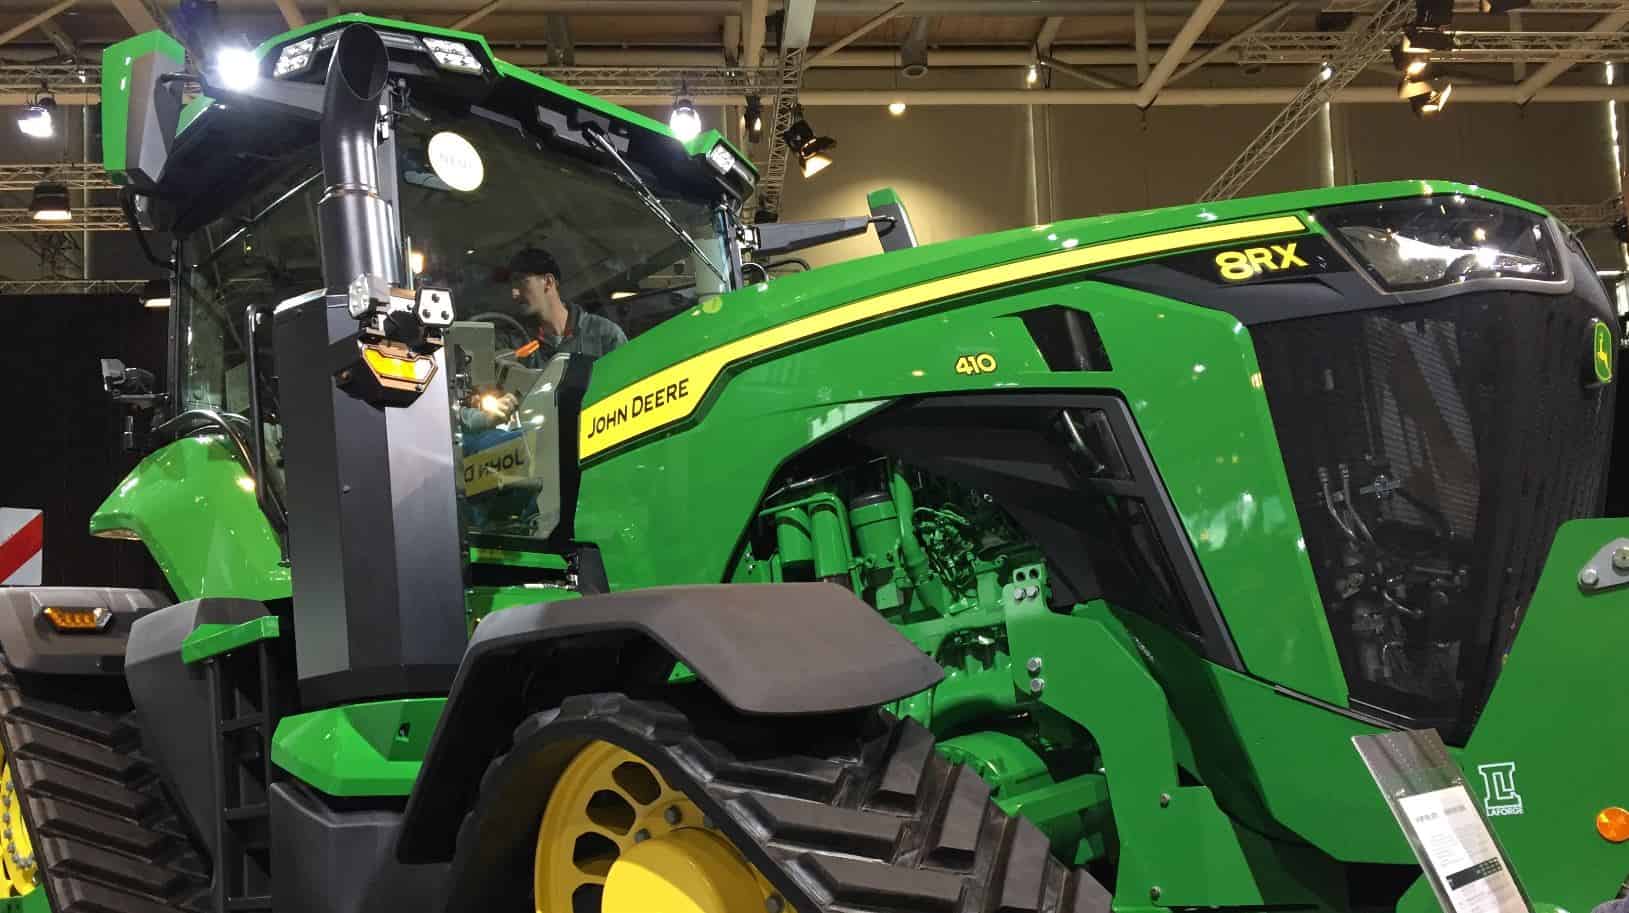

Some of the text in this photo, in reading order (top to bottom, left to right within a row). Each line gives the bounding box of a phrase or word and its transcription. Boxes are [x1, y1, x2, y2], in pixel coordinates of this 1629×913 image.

[1215, 242, 1309, 280] 8RX
[955, 353, 997, 375] 410
[587, 378, 689, 439] JOHN DEERE
